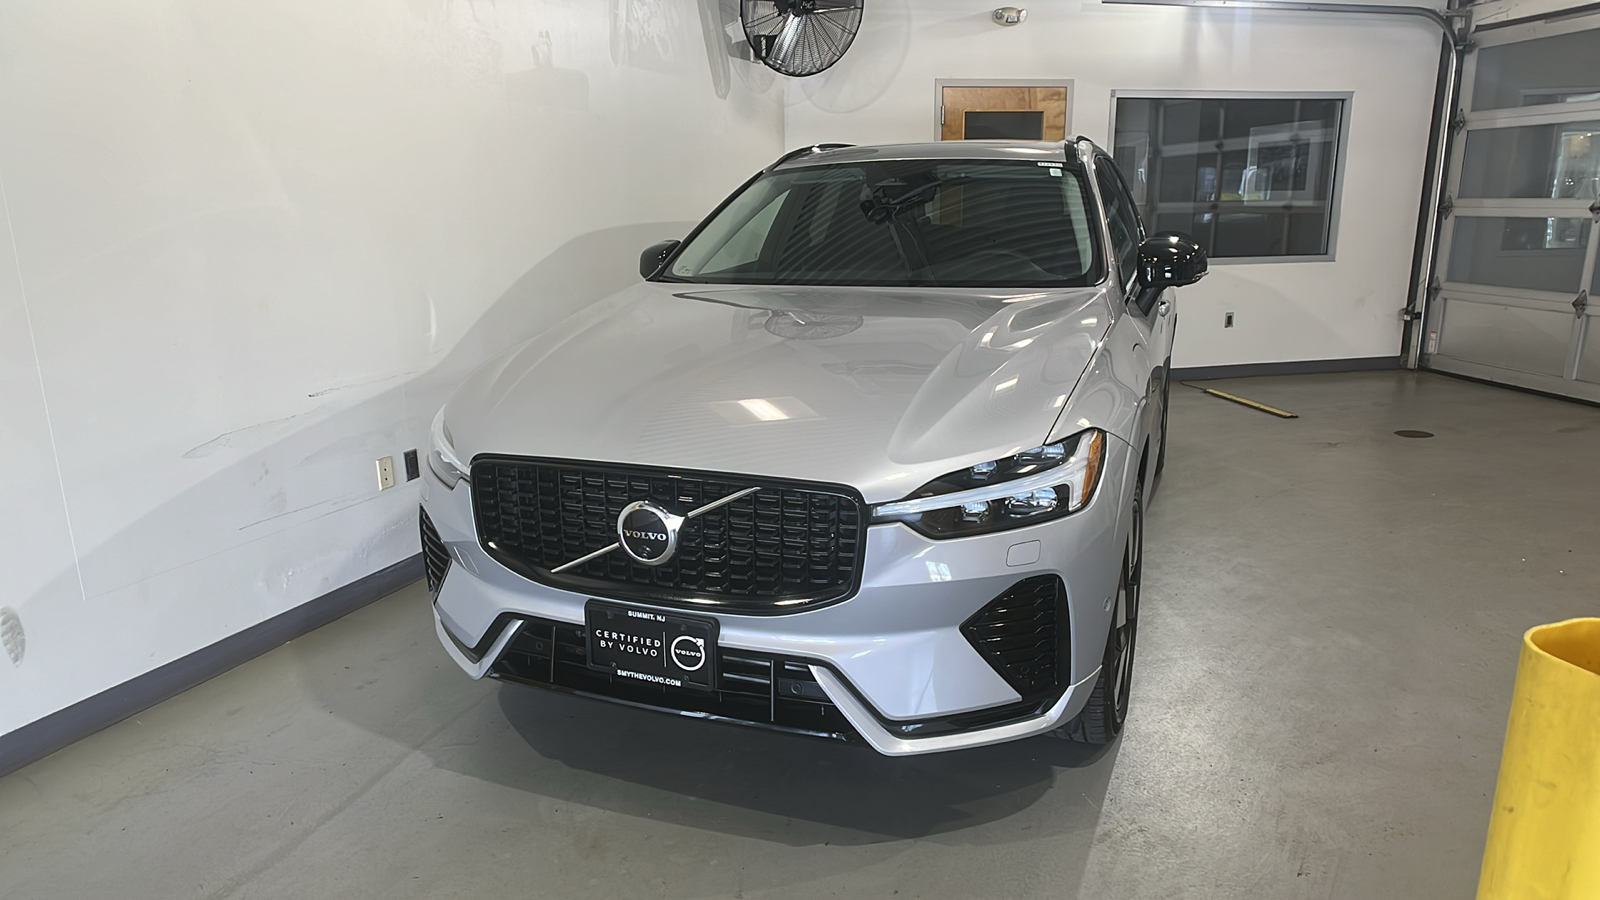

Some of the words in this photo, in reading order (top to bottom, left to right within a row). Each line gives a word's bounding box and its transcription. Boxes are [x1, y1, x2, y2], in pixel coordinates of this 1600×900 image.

[623, 529, 667, 541] VOLVO
[656, 614, 666, 622] NJ
[595, 629, 661, 647] CERTIFIED
[600, 640, 614, 649] BY
[619, 643, 658, 657] VOLVO
[675, 648, 701, 658] VOLVO
[617, 669, 681, 687] SMYTHEVOLVO.COM
